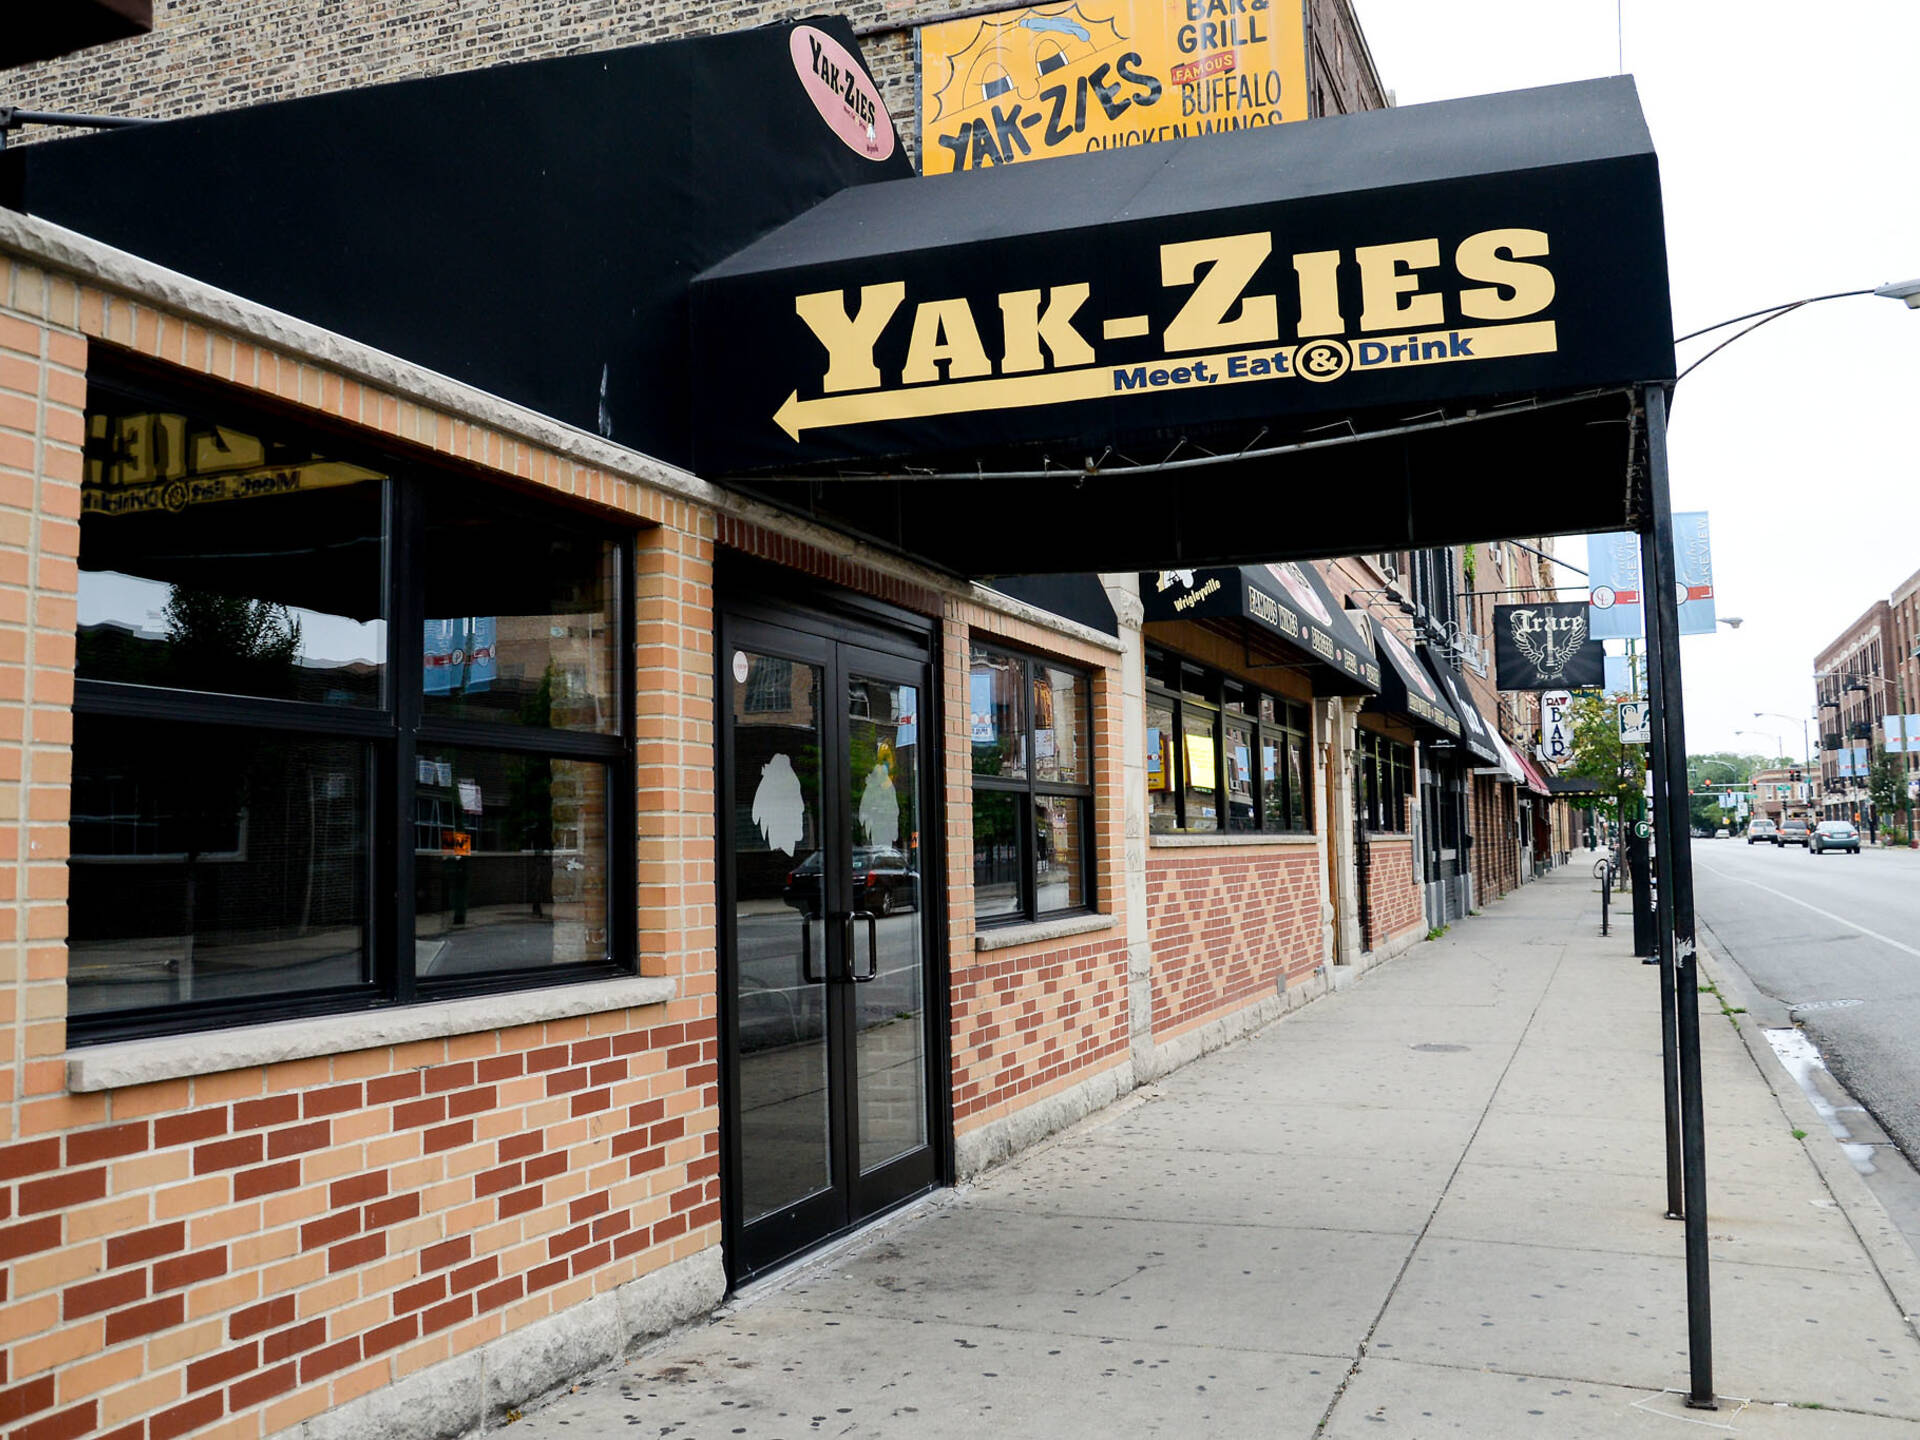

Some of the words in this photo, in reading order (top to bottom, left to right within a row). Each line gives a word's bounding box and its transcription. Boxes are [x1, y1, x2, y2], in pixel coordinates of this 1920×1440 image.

[1178, 16, 1267, 53] GRILL
[809, 34, 875, 125] YAK-ZIES
[1175, 54, 1233, 81] FAMOUS
[938, 52, 1162, 172] YAK-ZIES
[1182, 70, 1281, 117] BUFFALO
[796, 228, 1556, 393] YAK-ZIES
[1113, 361, 1220, 391] Meet,
[1227, 351, 1289, 378] Eat
[1308, 347, 1340, 372] &
[1359, 332, 1475, 366] Drink
[1625, 532, 1639, 602] LAKEVIE
[1698, 516, 1713, 598] LAKEVIEW
[1173, 578, 1221, 612] Wrigleyville
[1248, 586, 1278, 626] FAMOUS
[1510, 609, 1584, 632] Trace
[1639, 823, 1648, 835] P
